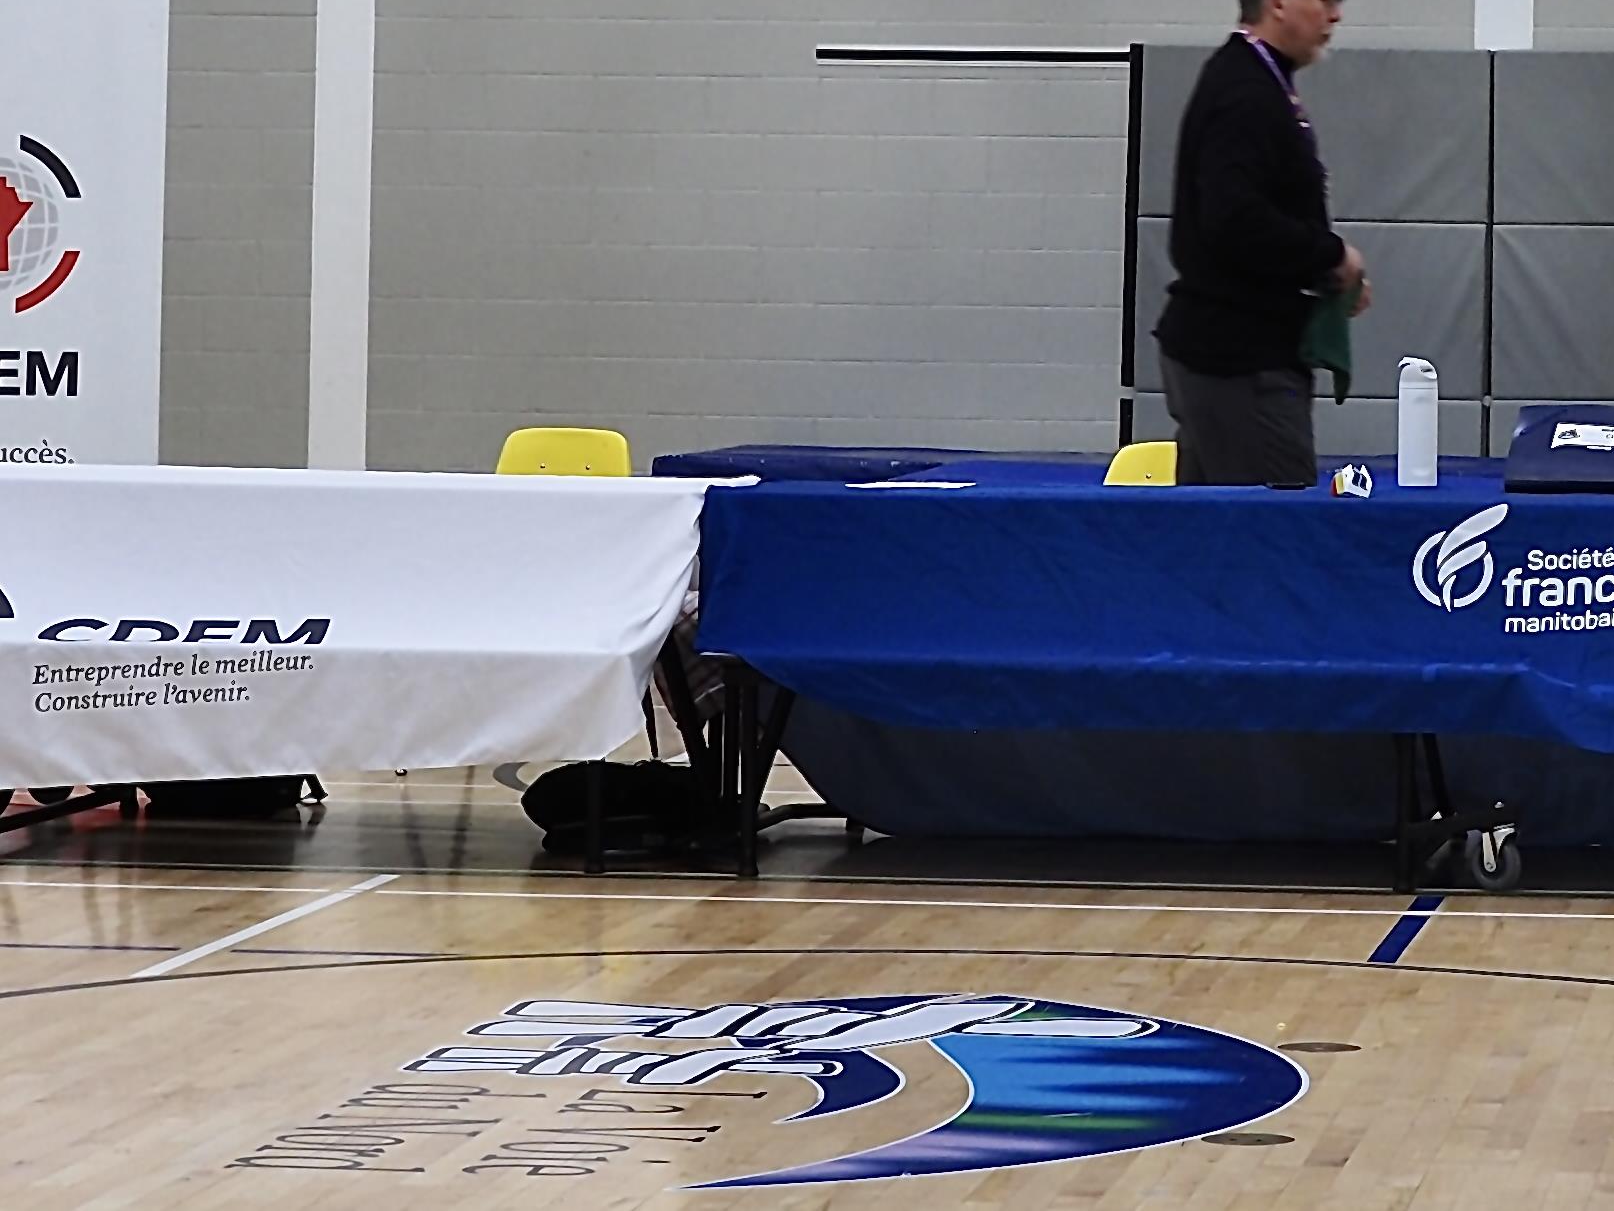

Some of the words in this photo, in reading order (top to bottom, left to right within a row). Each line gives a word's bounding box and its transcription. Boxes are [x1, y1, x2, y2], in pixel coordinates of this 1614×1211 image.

[31, 655, 185, 687] Entreprendre
[190, 653, 211, 676] le
[214, 649, 315, 675] meilleur.
[34, 684, 158, 713] Construire
[163, 678, 251, 706] l'avenir.
[338, 1082, 547, 1109] du
[557, 1088, 768, 1114] La
[222, 1113, 503, 1173] Nord
[462, 1124, 722, 1177] Voie
